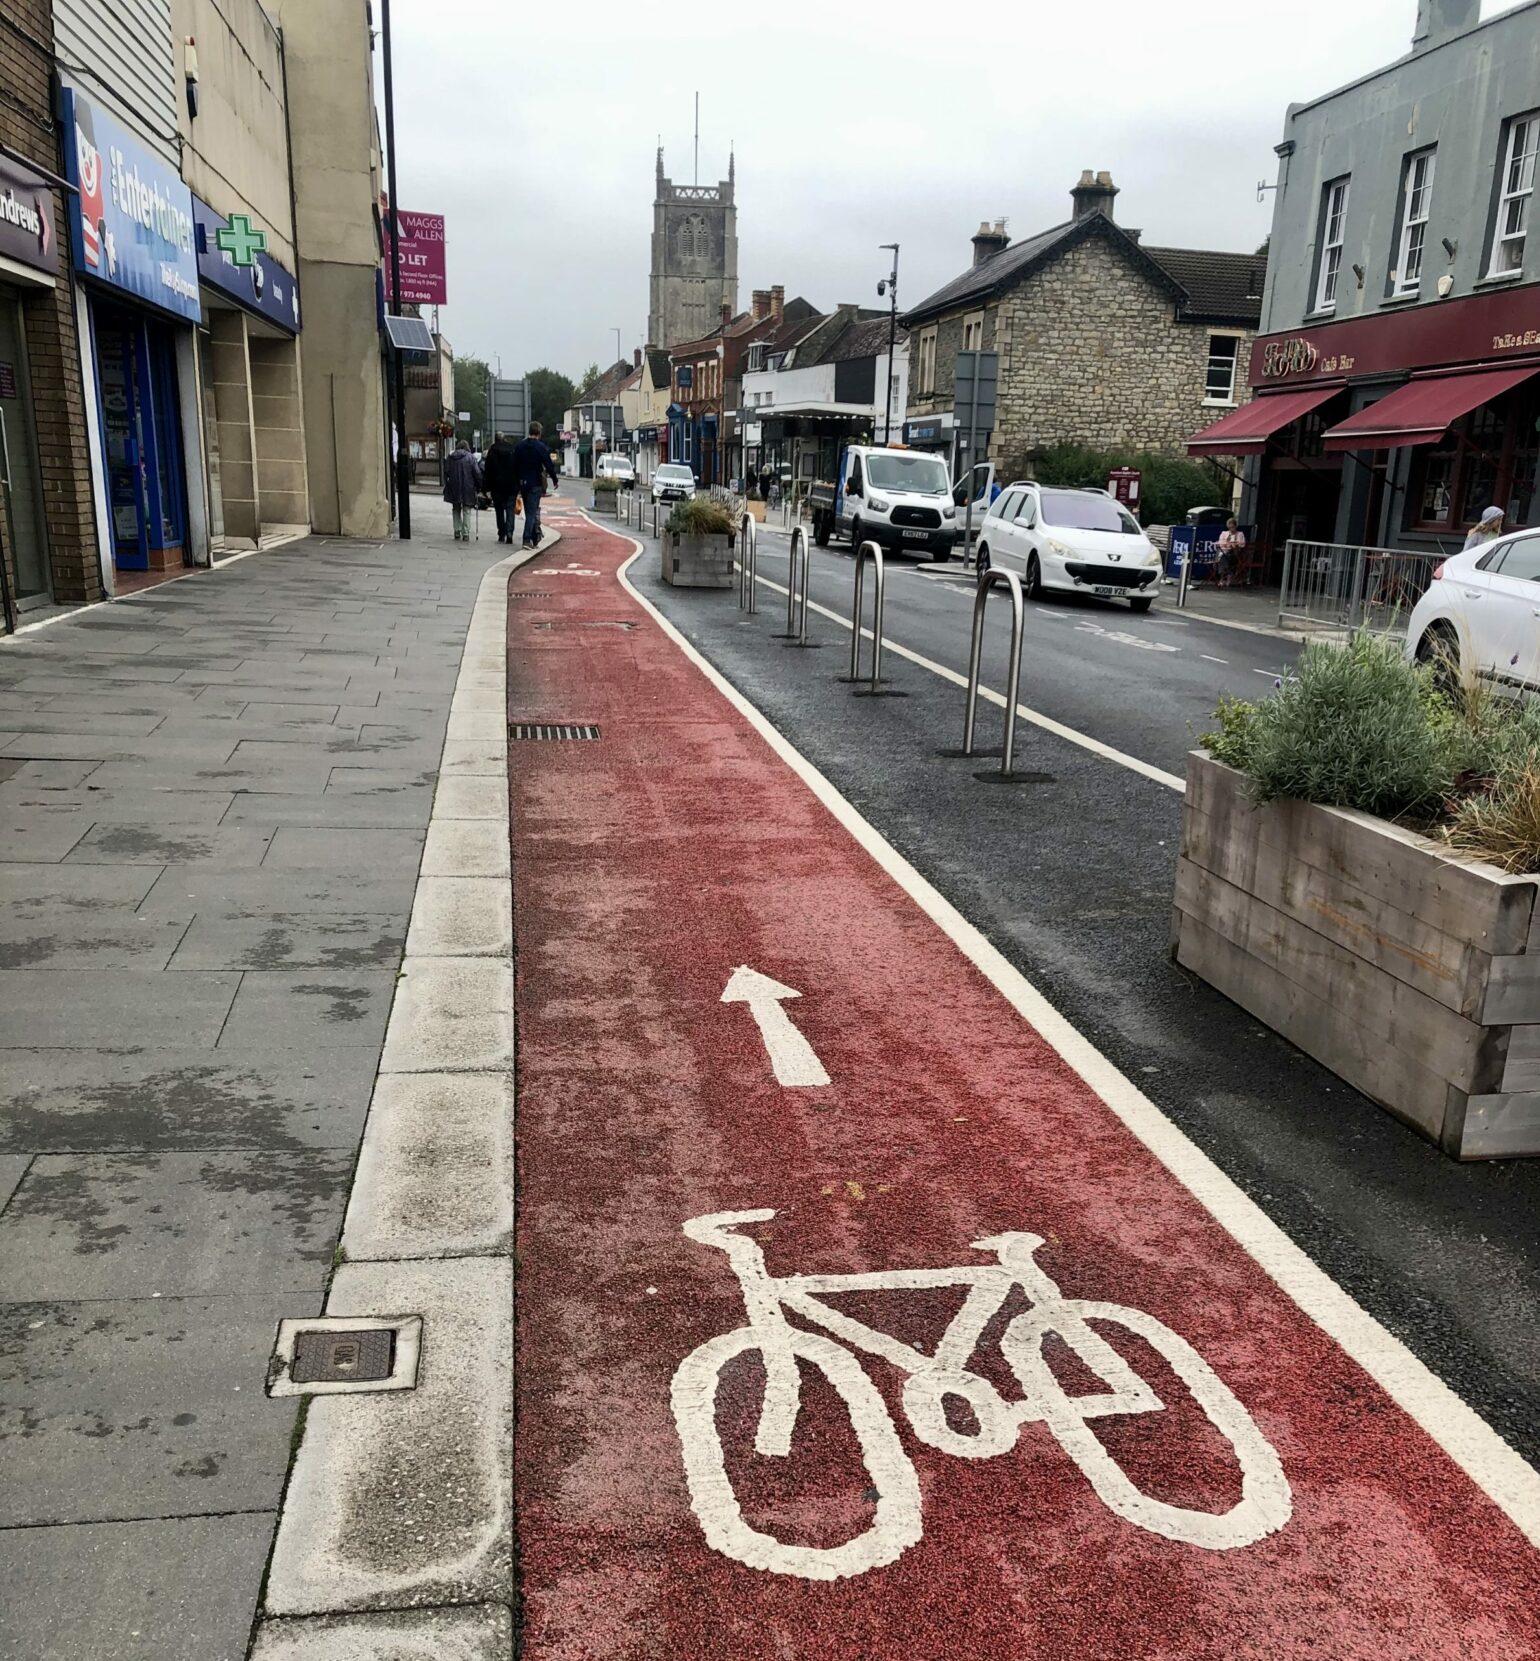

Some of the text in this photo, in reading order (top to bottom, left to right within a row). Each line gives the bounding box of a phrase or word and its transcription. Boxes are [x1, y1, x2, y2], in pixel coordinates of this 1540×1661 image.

[116, 149, 192, 254] Entertainer
[0, 188, 40, 236] ndrews
[406, 216, 443, 230] MAGGS
[414, 229, 443, 241] ALLEN
[408, 254, 427, 266] LET
[1338, 354, 1355, 370] Bar
